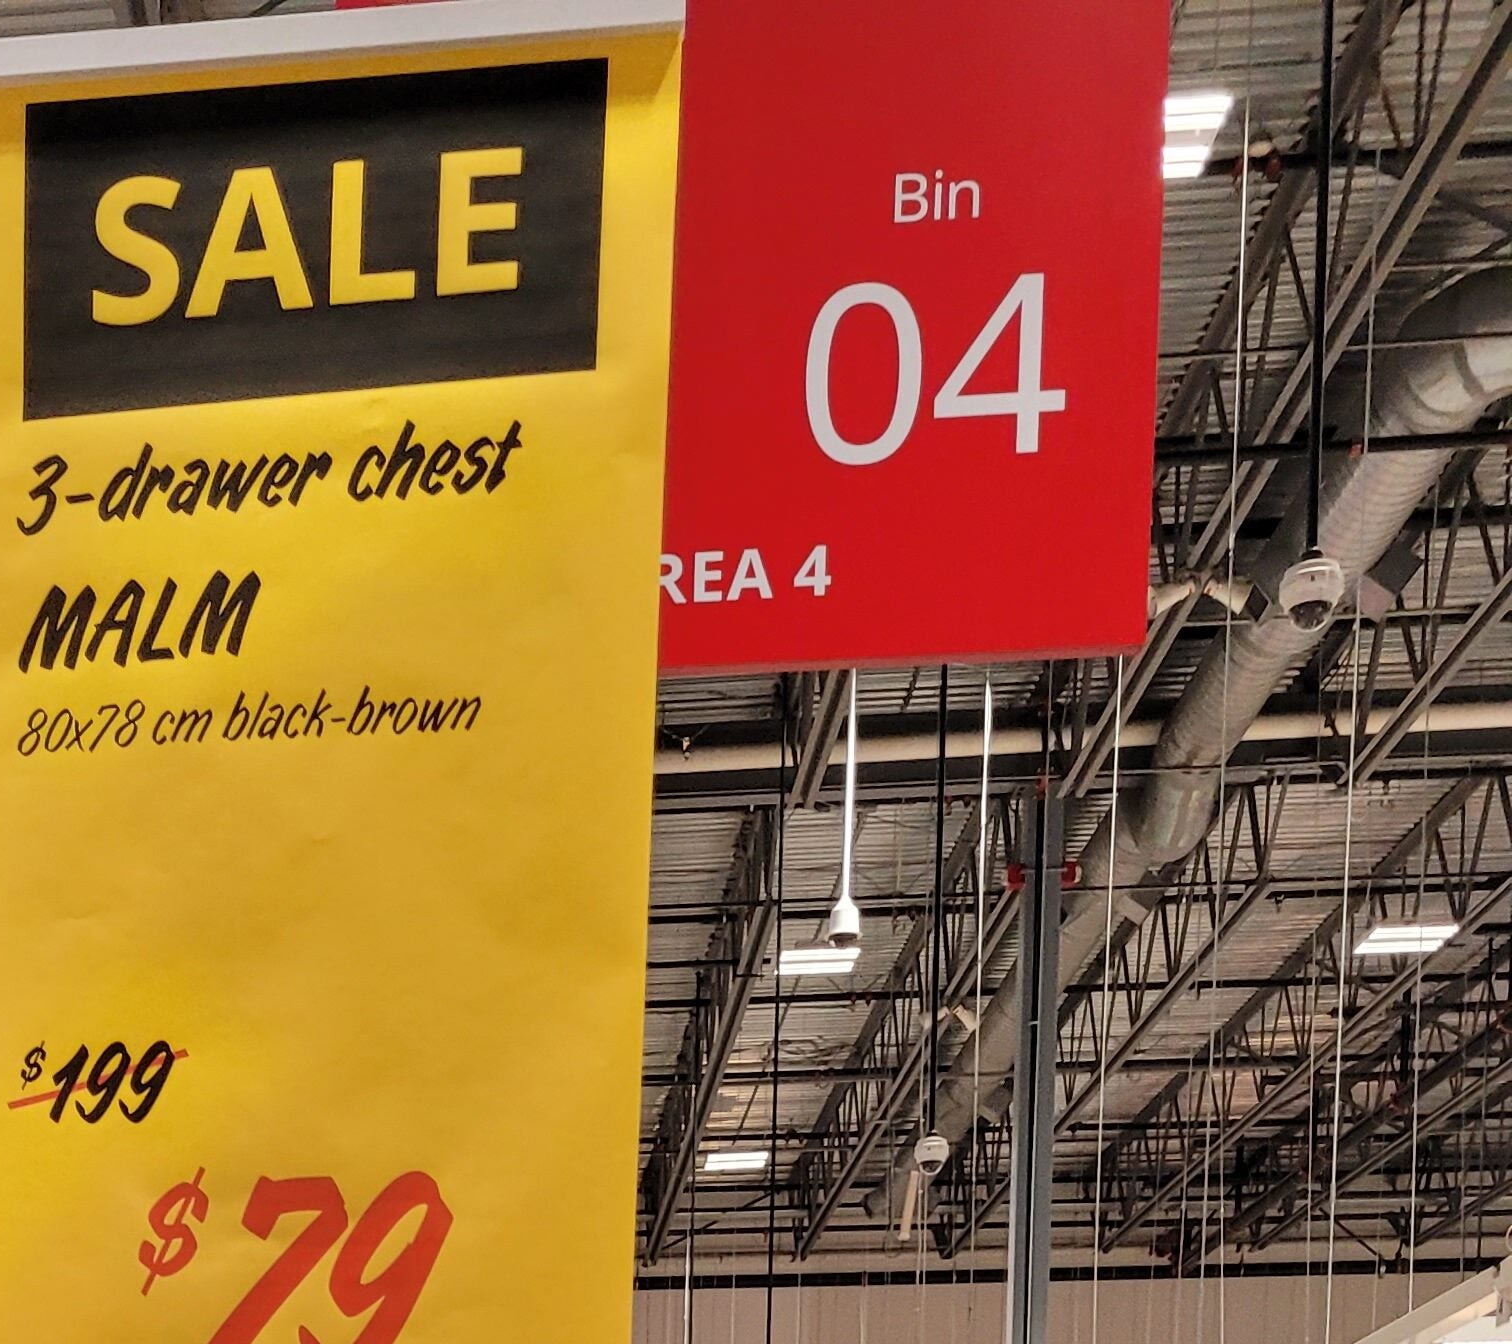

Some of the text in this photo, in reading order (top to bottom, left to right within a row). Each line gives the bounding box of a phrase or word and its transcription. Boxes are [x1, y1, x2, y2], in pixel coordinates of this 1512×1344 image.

[92, 147, 523, 326] SALE
[894, 169, 980, 224] Bin
[806, 272, 1066, 466] 04
[17, 419, 523, 536] 3-drawer chest
[659, 545, 832, 604] REA 4
[18, 570, 261, 674] MALM
[17, 684, 482, 756] 80x78 cm black-brown
[21, 1041, 178, 1124] $199
